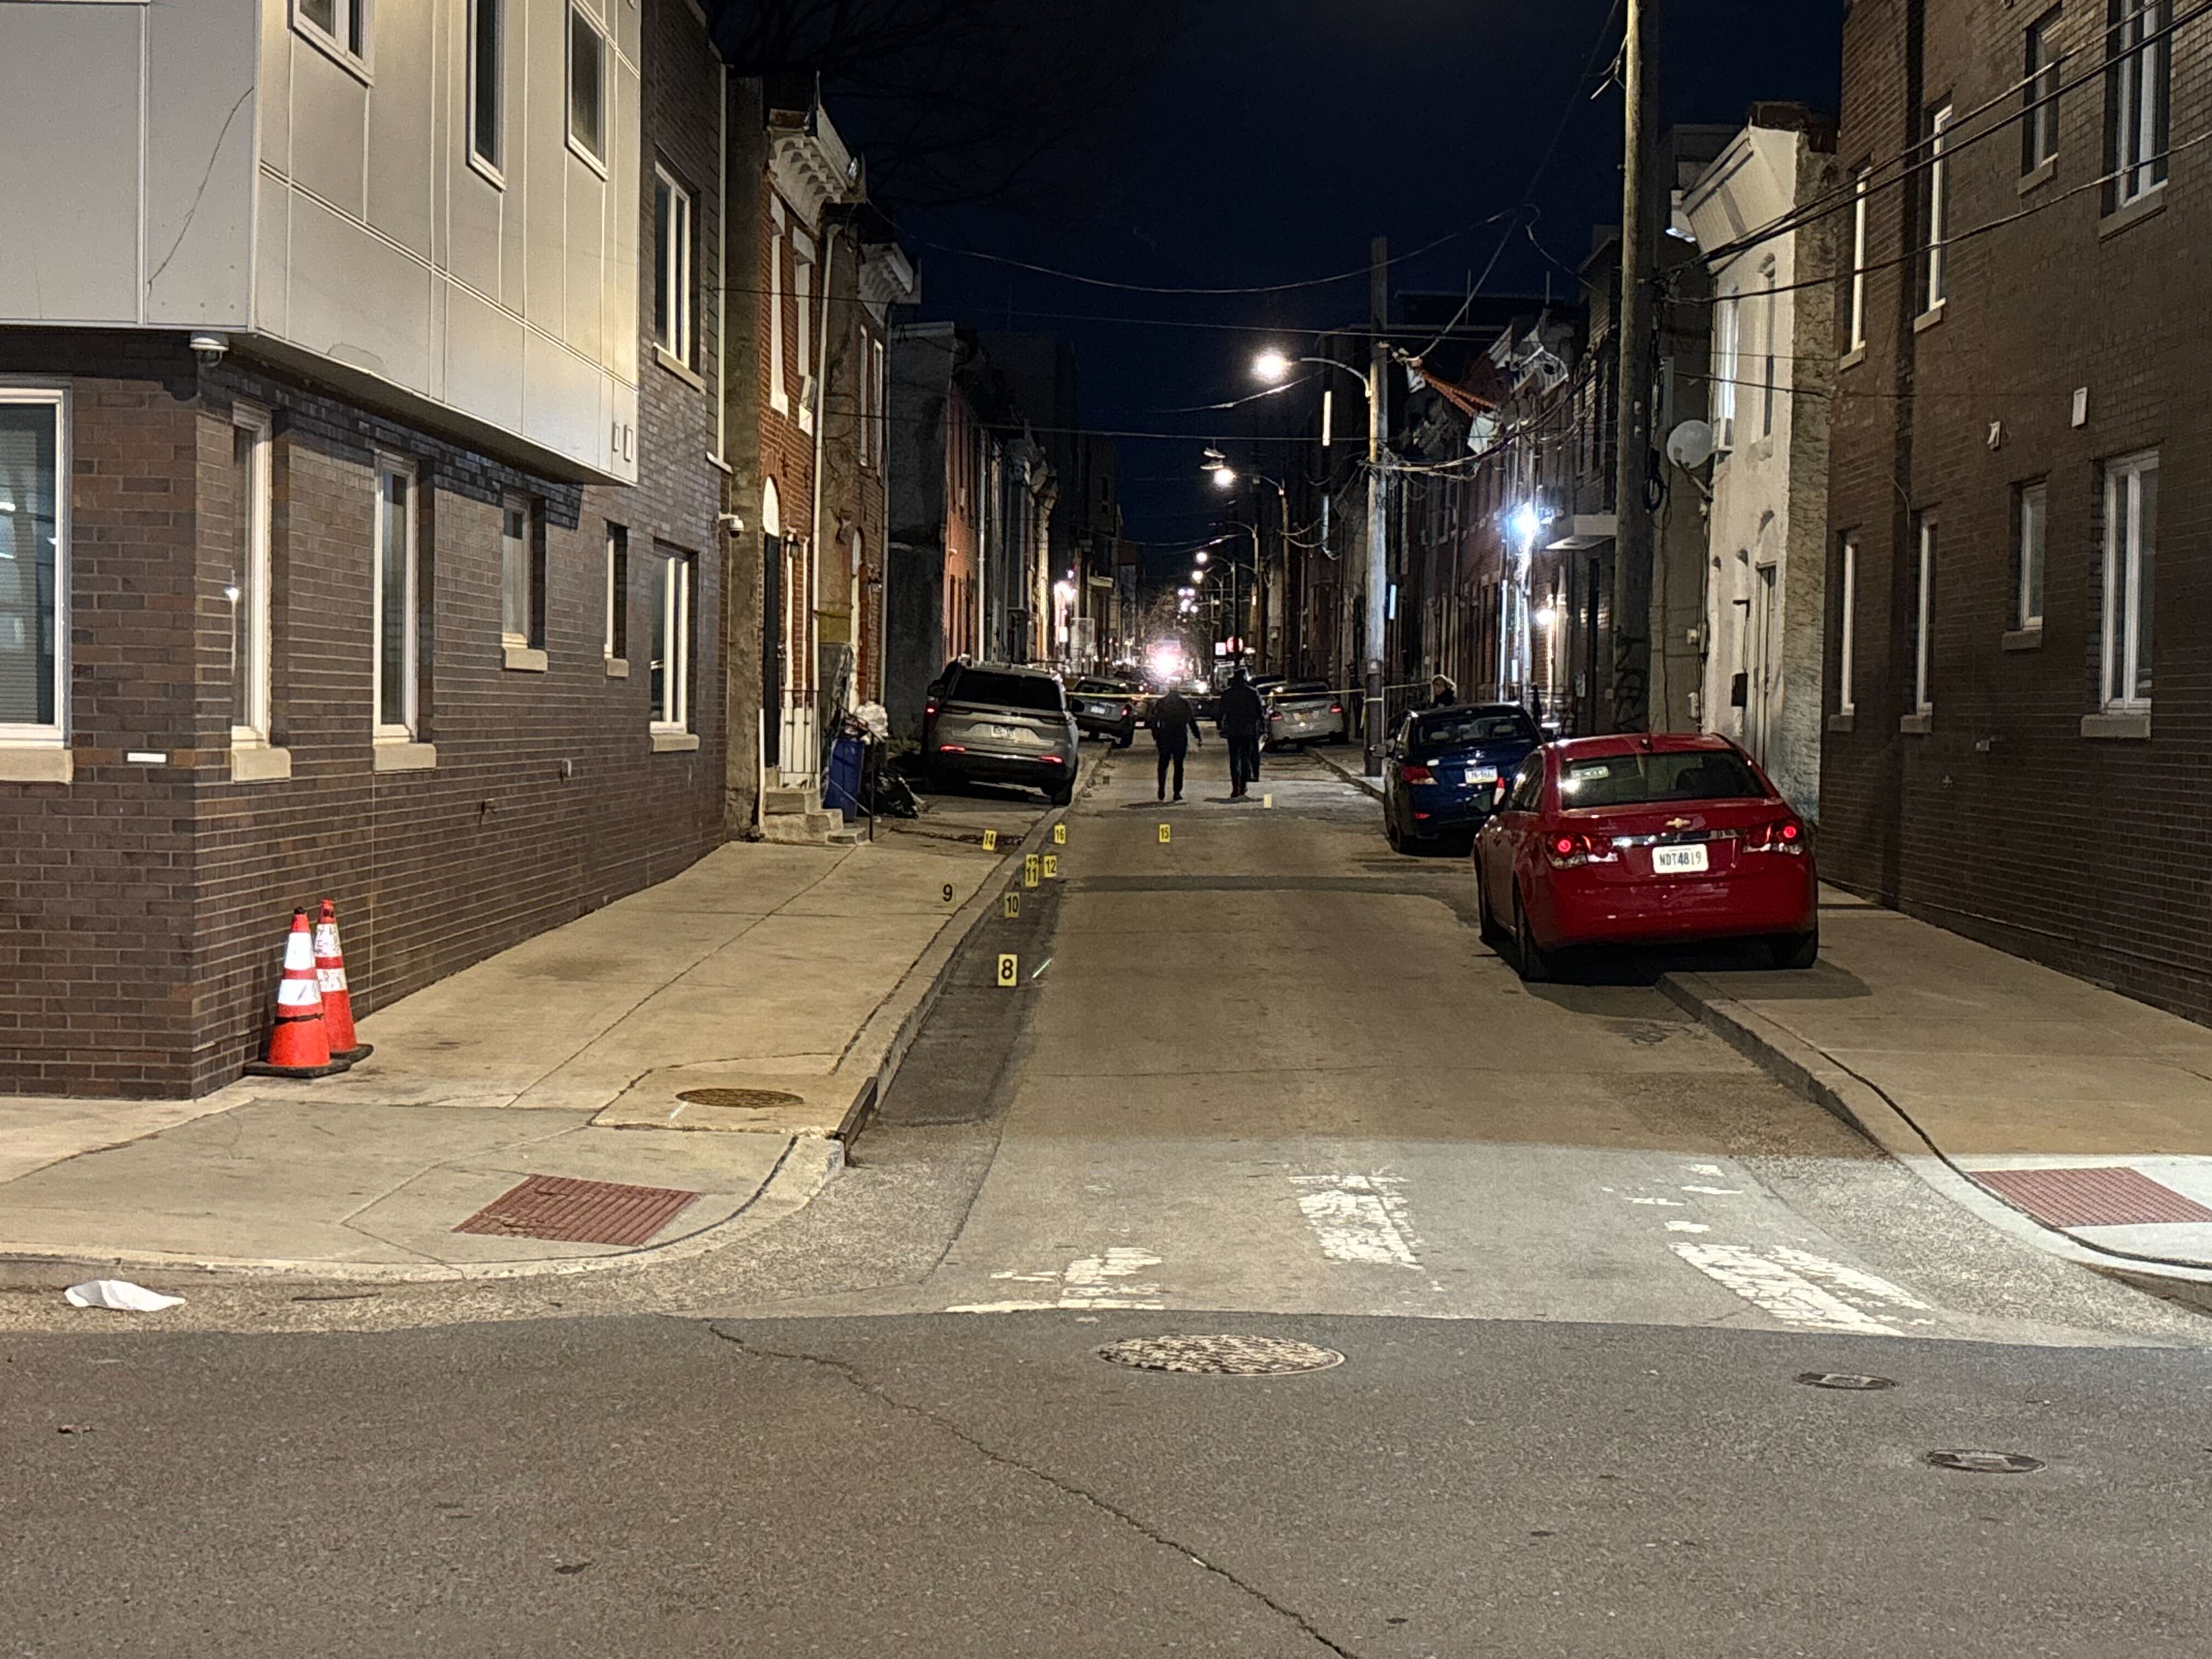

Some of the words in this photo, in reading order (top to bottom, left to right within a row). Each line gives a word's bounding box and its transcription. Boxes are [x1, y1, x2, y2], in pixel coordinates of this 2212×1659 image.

[985, 833, 994, 847] 14
[1056, 828, 1064, 841] 16
[1160, 826, 1169, 839] 15
[1046, 859, 1056, 873] 12
[1660, 851, 1701, 866] NDT4819
[1027, 867, 1036, 883] 11
[943, 884, 953, 902] 9
[1006, 895, 1019, 913] 10
[1001, 958, 1013, 980] 8
